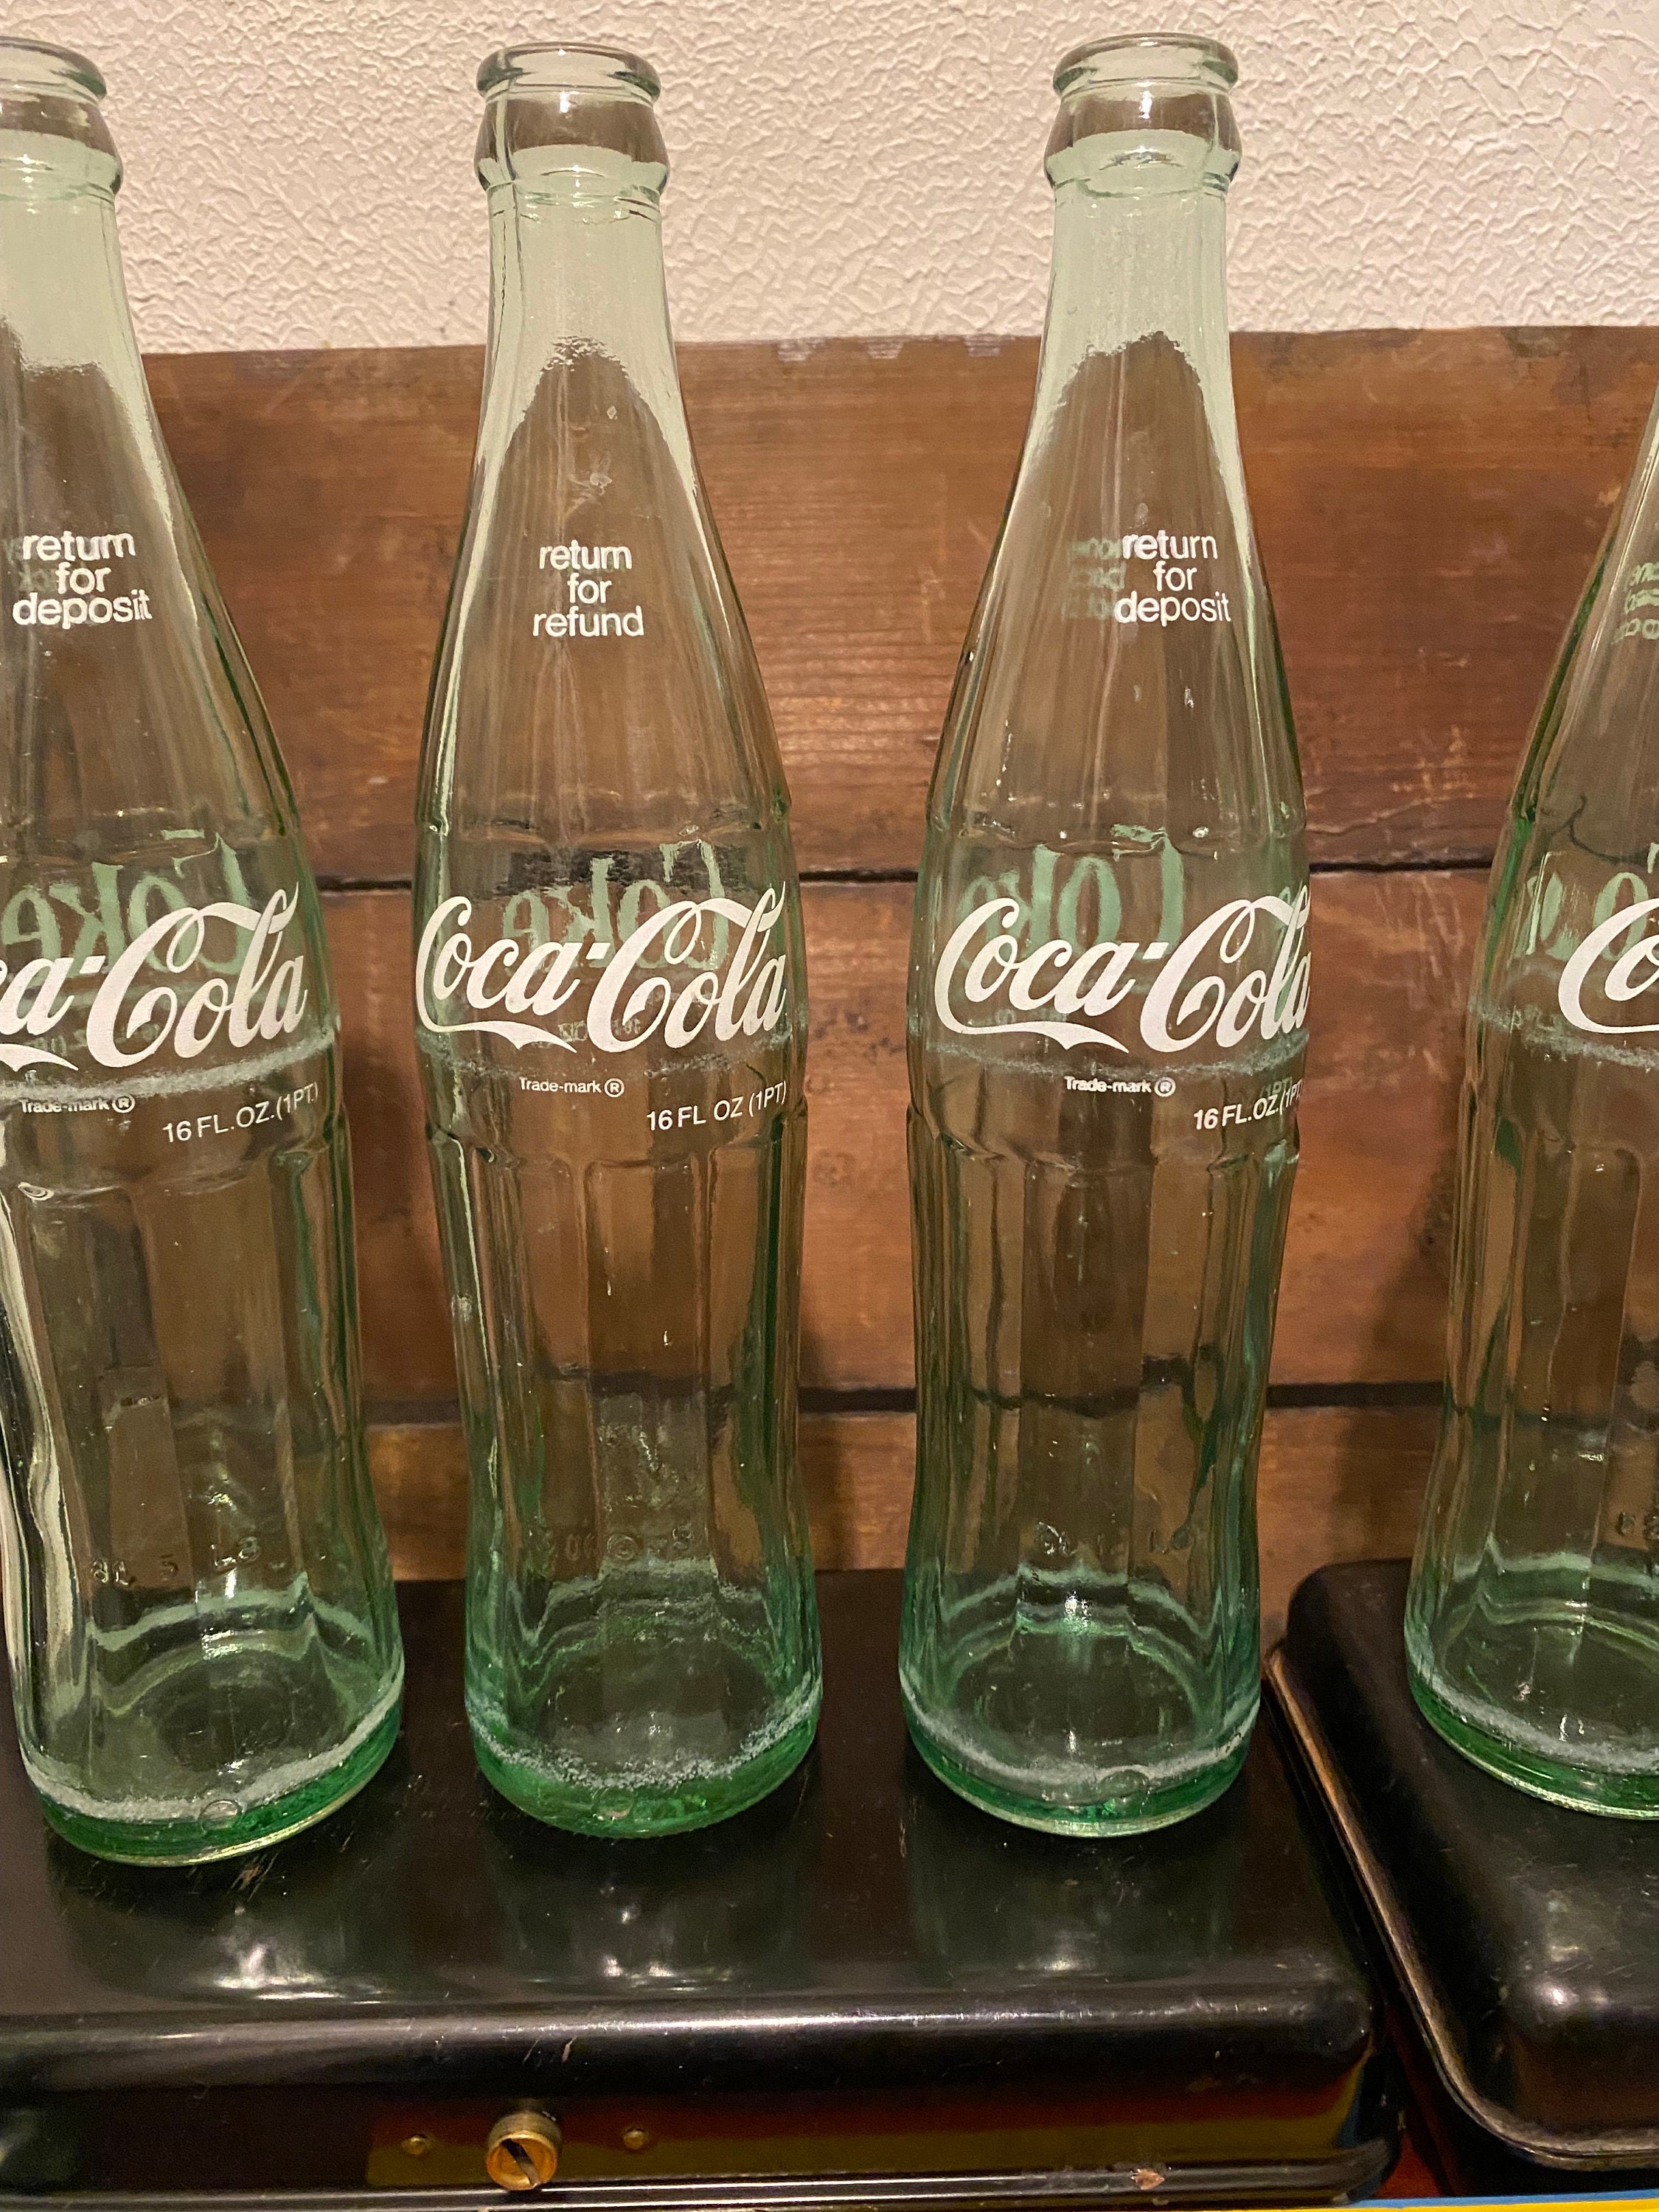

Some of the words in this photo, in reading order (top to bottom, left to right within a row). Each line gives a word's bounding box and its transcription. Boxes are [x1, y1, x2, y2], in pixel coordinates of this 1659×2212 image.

[23, 531, 136, 561] return
[539, 540, 633, 570] return
[1121, 530, 1218, 560] return
[55, 561, 111, 594] for
[567, 572, 613, 604] for
[1152, 560, 1198, 591] for
[13, 589, 153, 630] deposit
[532, 605, 644, 637] refund
[1113, 591, 1231, 627] deposit
[0, 882, 308, 1071] a-Cola
[416, 881, 787, 1053] Coca-Cola
[934, 885, 1310, 1053] Coca-Cola
[519, 1077, 602, 1094] Trade-mark
[1064, 1076, 1152, 1093] Trade-mark
[18, 1098, 110, 1114] Trade-mark
[646, 1109, 673, 1131] 16
[678, 1105, 706, 1128] FL
[714, 1096, 745, 1121] OZ
[1194, 1107, 1220, 1130] 16
[162, 1120, 192, 1143] 16
